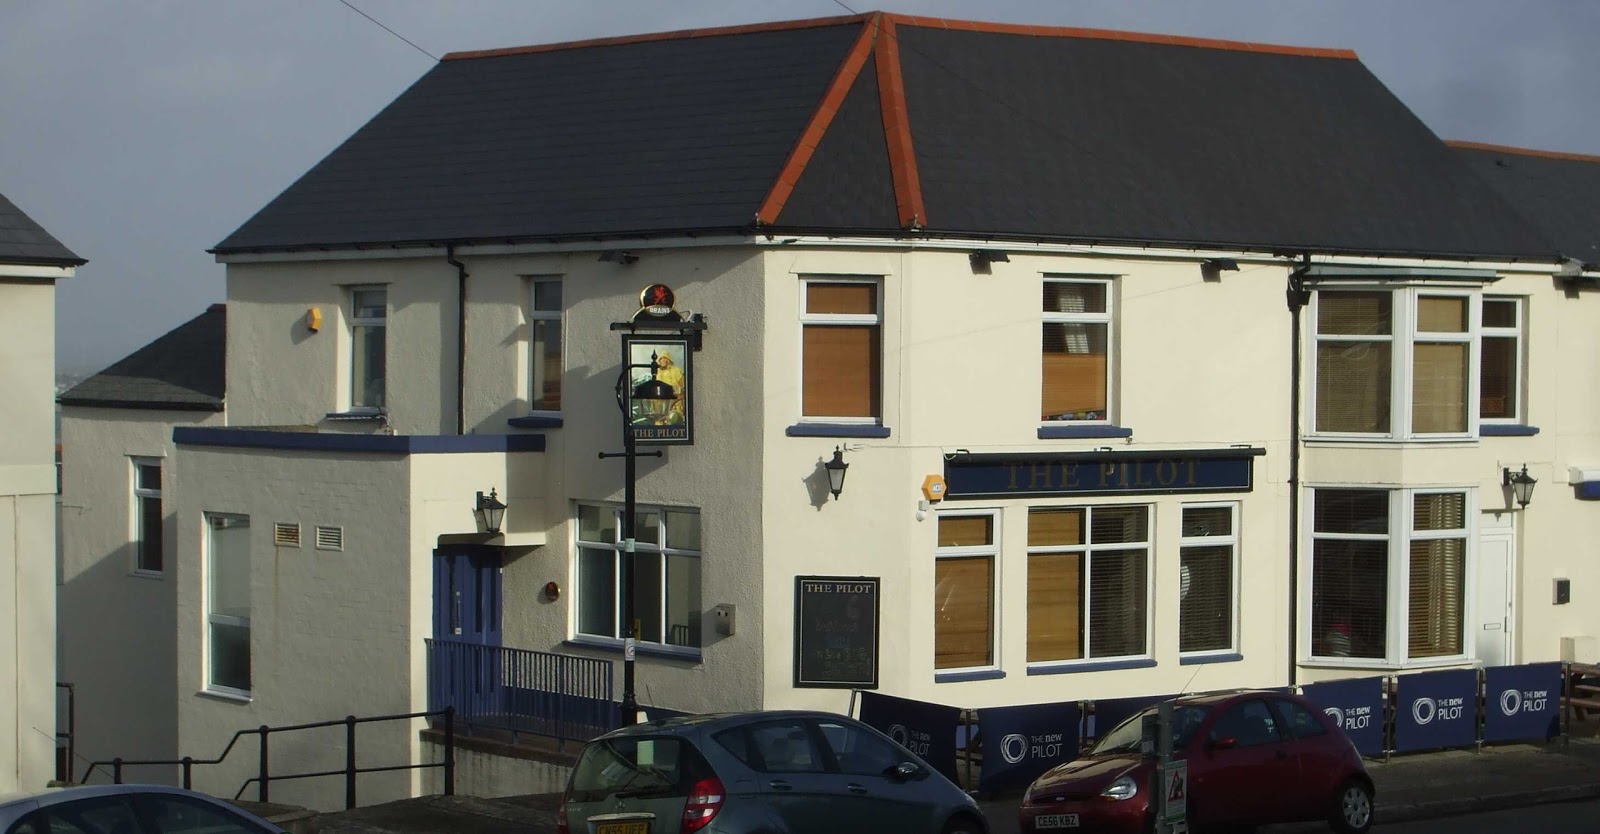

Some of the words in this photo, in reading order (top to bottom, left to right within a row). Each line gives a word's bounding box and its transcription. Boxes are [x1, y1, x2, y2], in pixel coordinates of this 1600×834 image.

[633, 428, 654, 438] THE
[657, 428, 686, 438] PILOT
[1008, 461, 1080, 489] THE
[1098, 457, 1201, 487] PILOT
[805, 584, 832, 593] THE
[836, 584, 872, 594] PILOT
[1523, 691, 1534, 699] THE
[1534, 689, 1548, 698] new
[1438, 699, 1449, 707] THE
[1449, 697, 1464, 706] new
[1523, 698, 1548, 712] PILOT
[1345, 707, 1356, 715] THE
[1356, 705, 1371, 714] new
[1438, 706, 1464, 720] PILOT
[1345, 714, 1371, 730] PILOT
[911, 730, 920, 739] THE
[919, 731, 931, 742] new
[1031, 735, 1044, 744] THE
[1044, 732, 1062, 743] new
[909, 740, 931, 757] PILOT
[1031, 743, 1063, 759] PILOT
[1038, 815, 1058, 827] CE56
[1059, 814, 1077, 826] KBZ
